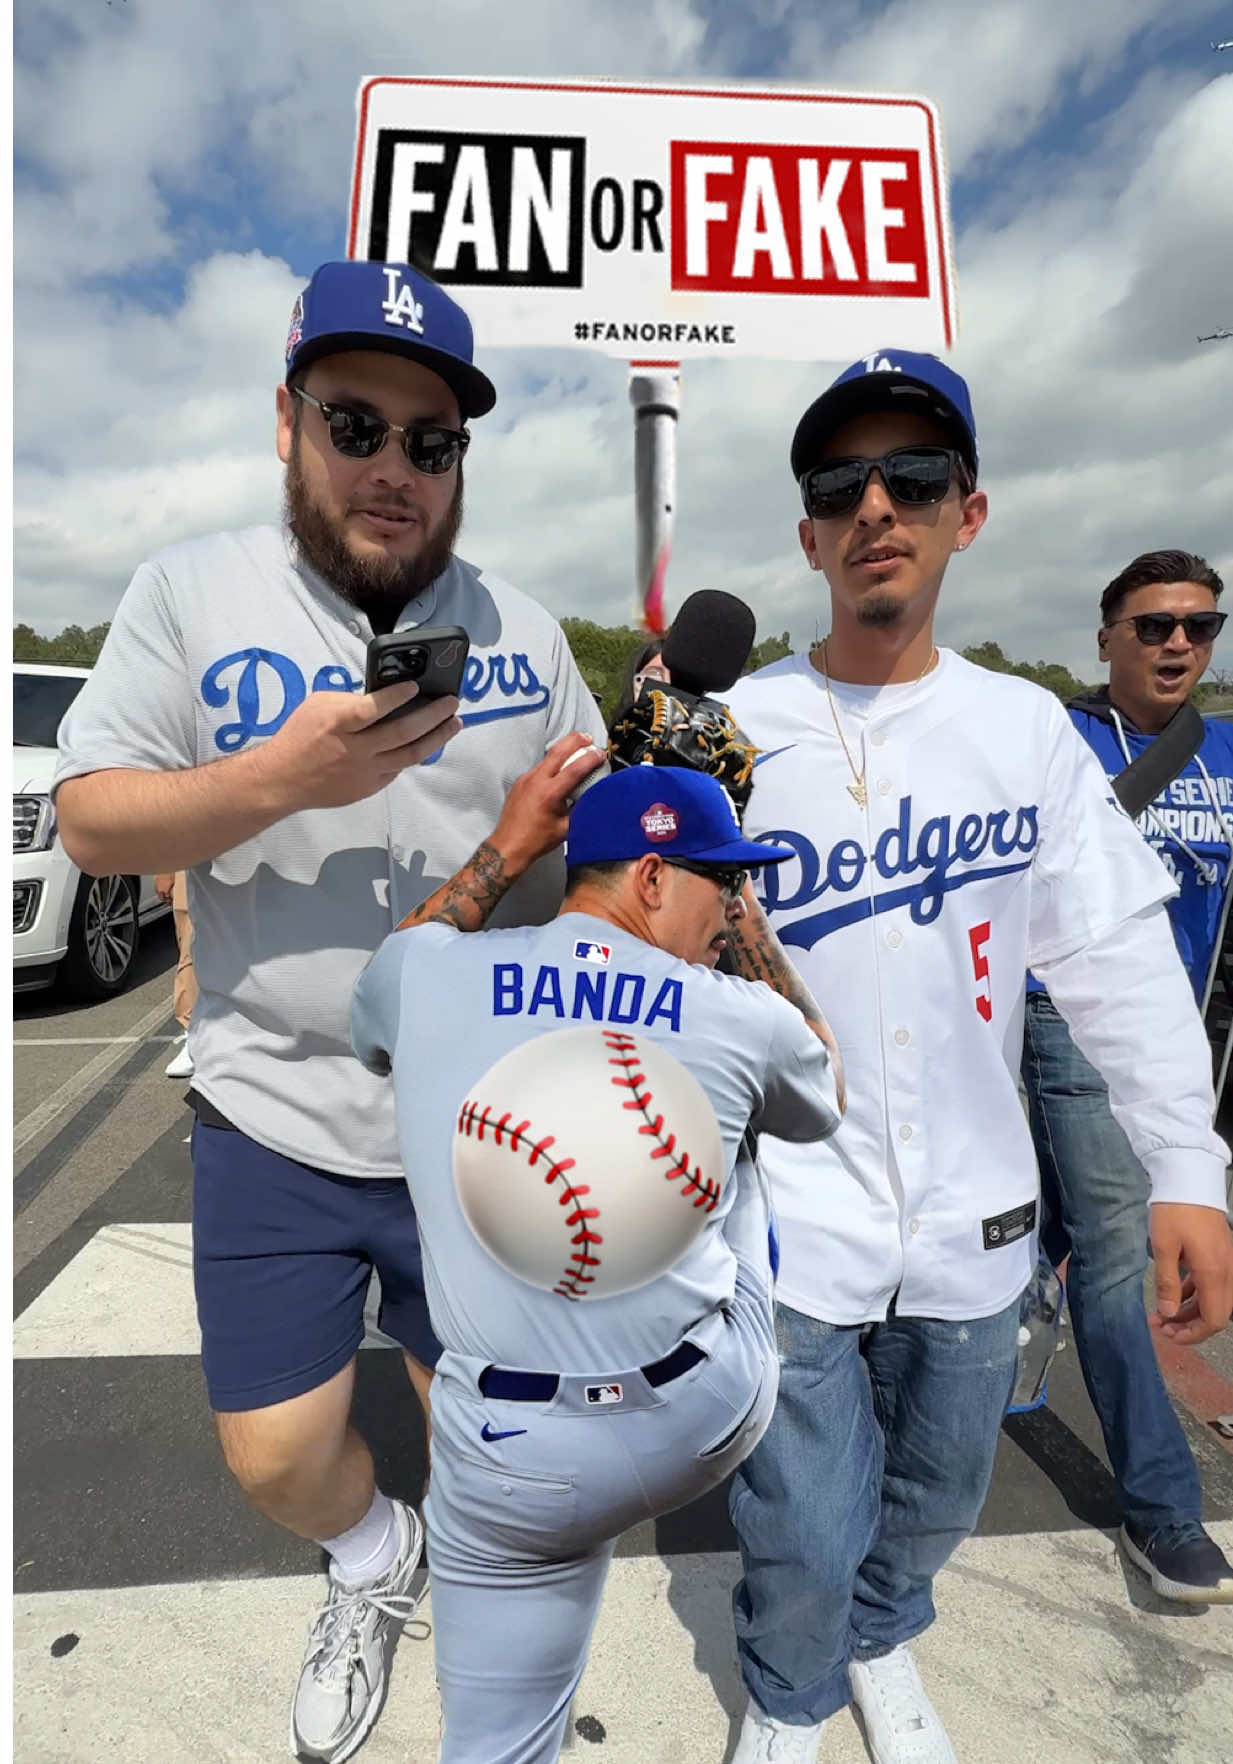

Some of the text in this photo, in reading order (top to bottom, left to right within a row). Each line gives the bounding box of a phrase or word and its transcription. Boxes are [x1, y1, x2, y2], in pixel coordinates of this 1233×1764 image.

[386, 141, 918, 284] FAN OR FAKE
[381, 267, 424, 335] LA
[573, 321, 737, 344] #FANORFAKE
[201, 647, 541, 753] Doers
[752, 795, 1039, 927] Dodgers
[492, 962, 684, 1033] BANDA
